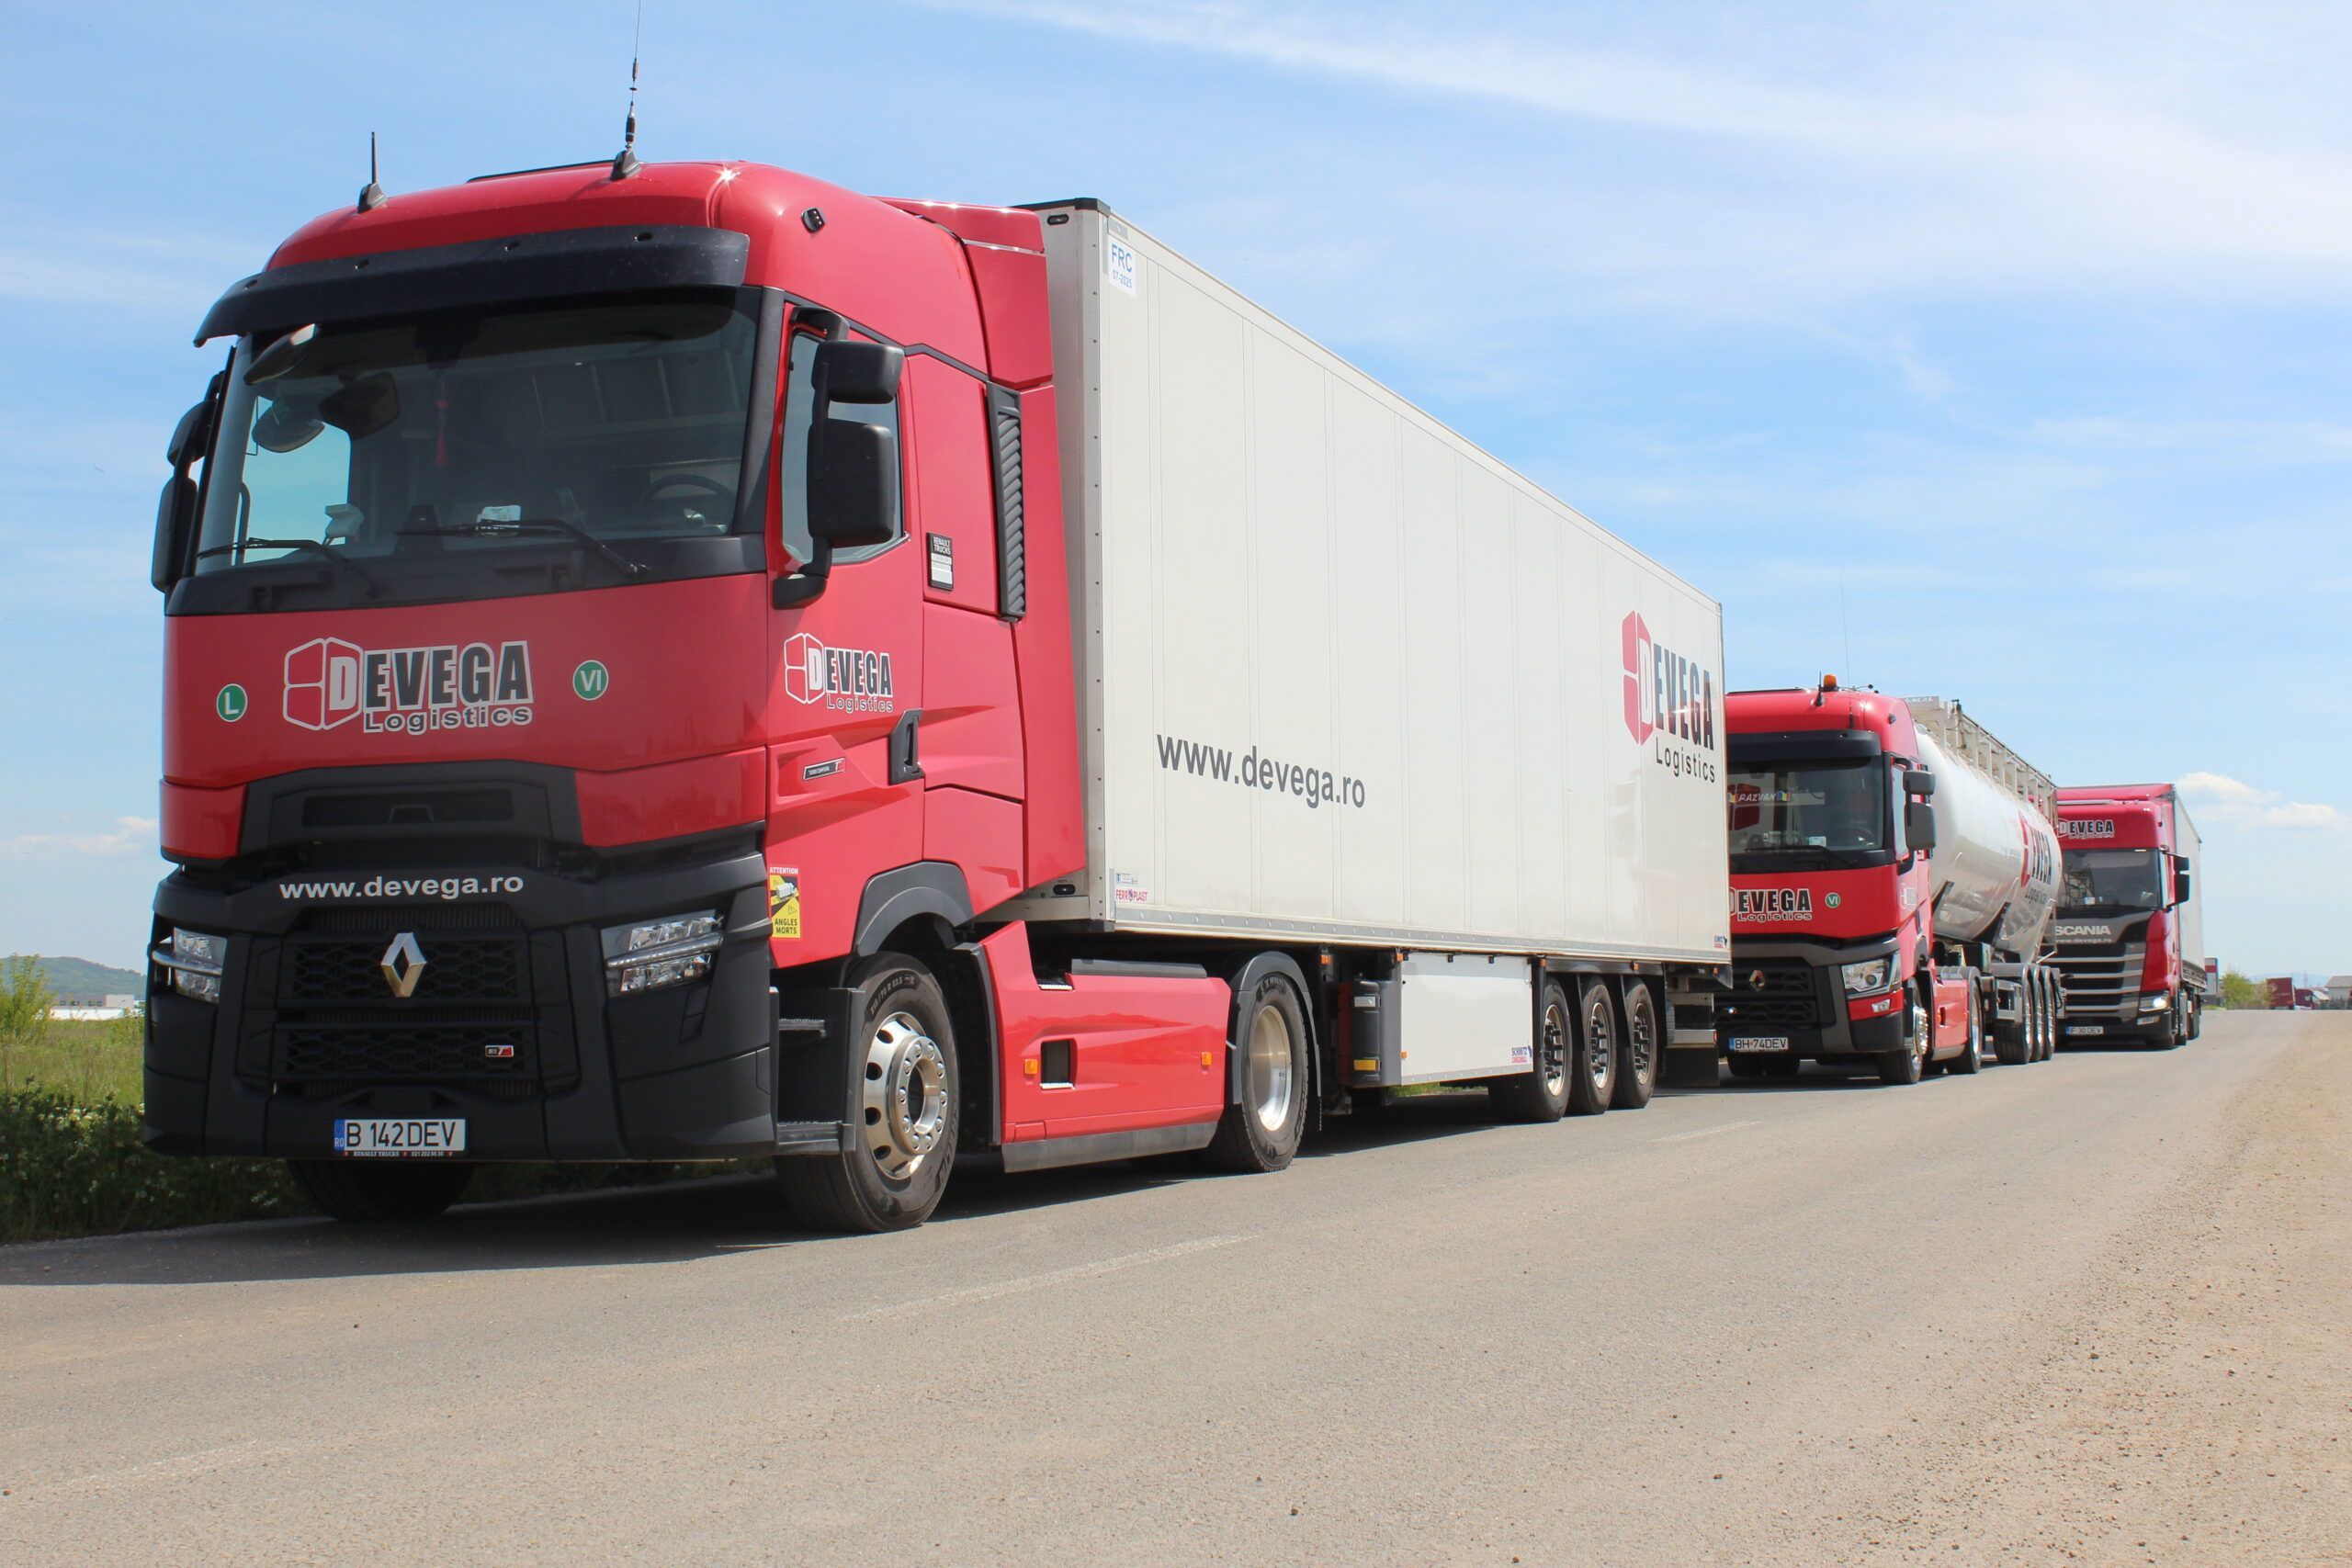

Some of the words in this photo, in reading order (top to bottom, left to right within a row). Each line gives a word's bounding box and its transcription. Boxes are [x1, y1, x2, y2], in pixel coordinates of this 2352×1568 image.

[1112, 243, 1132, 273] FRC
[329, 640, 534, 711] DEVEGA
[581, 670, 602, 692] VI
[808, 646, 893, 698] DEVEGA
[224, 690, 240, 715] L
[827, 694, 894, 713] Logistics
[1639, 637, 1714, 750] DEVEGA
[364, 705, 533, 735] Logistics
[1156, 734, 1365, 808] www.devega.ro
[1656, 737, 1715, 783] Logistics
[1738, 793, 1776, 802] RAZVAN
[2059, 819, 2115, 834] DEVEGA
[769, 866, 798, 874] ATTENTION
[279, 875, 524, 899] www.devega.ro
[1827, 896, 1838, 905] VI
[1737, 912, 1813, 922] Logistics
[2055, 925, 2112, 936] SCANIA
[334, 1137, 345, 1147] RO
